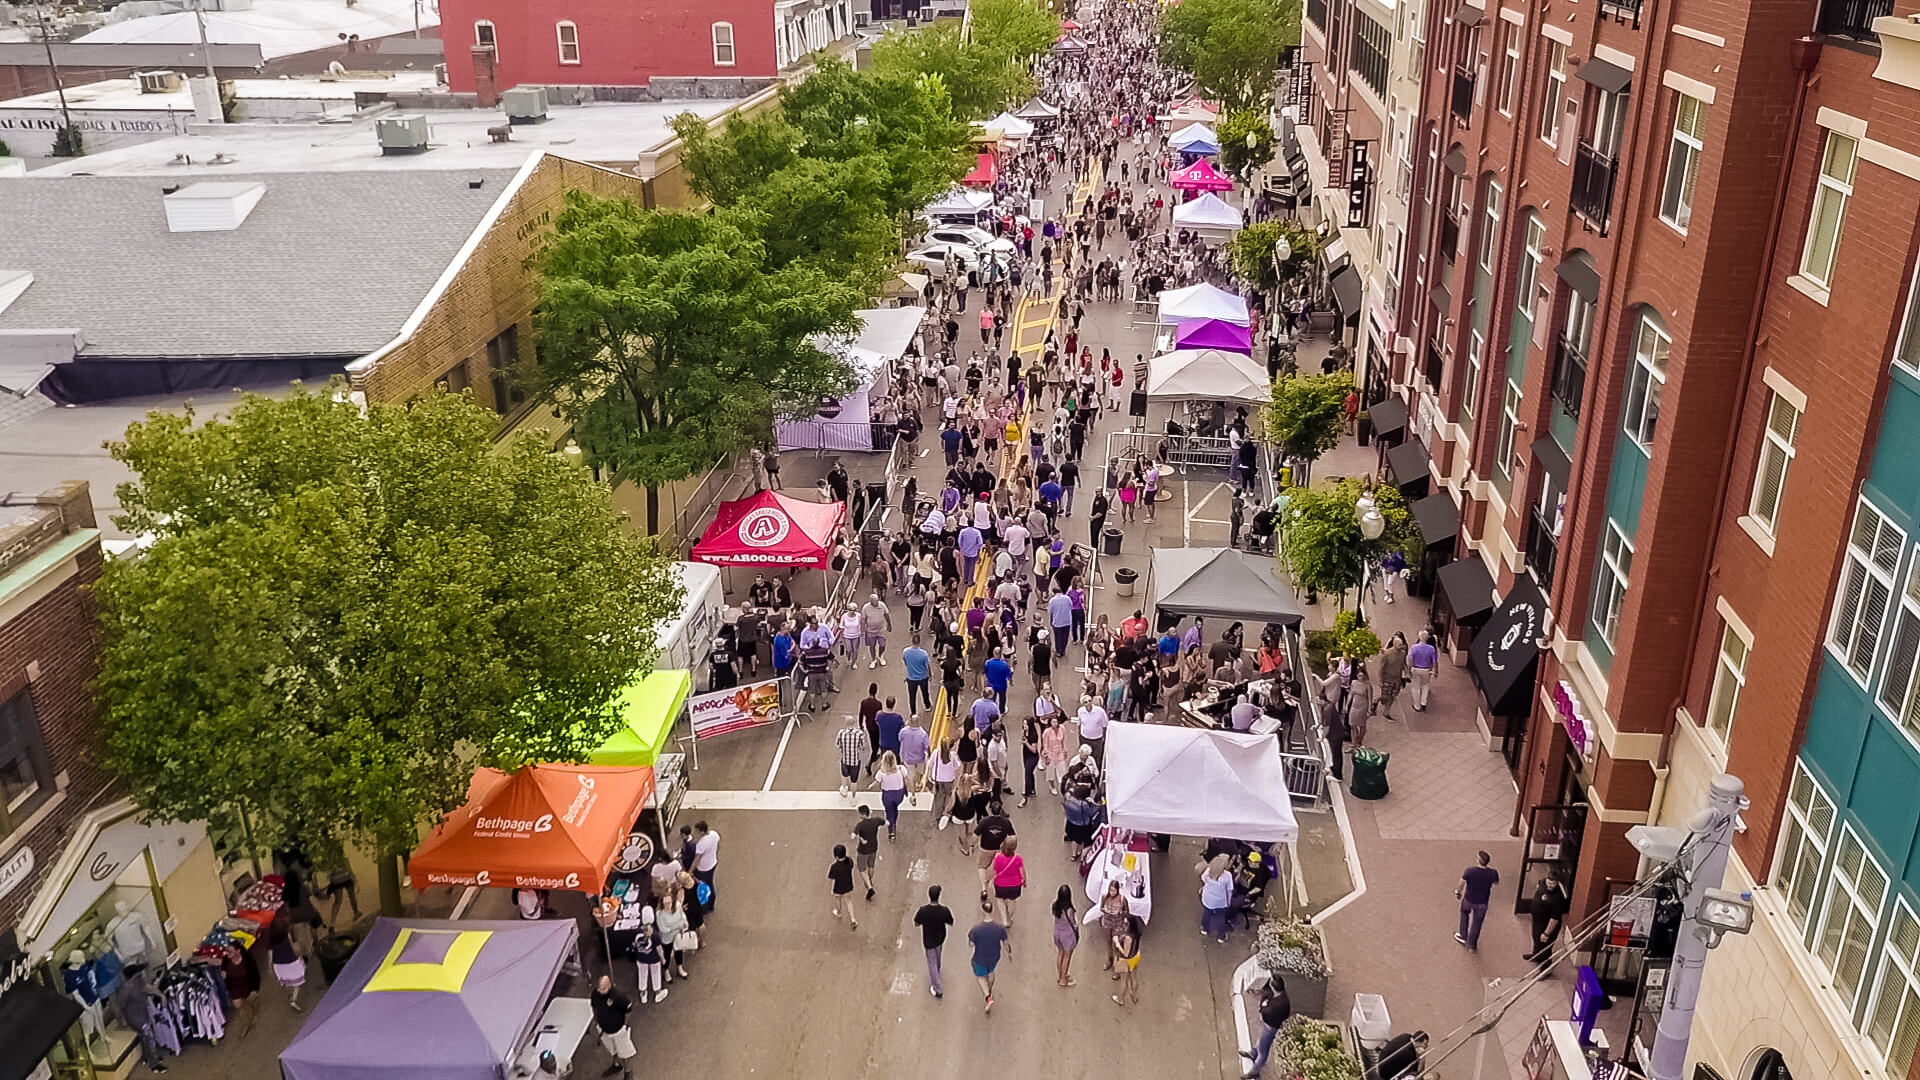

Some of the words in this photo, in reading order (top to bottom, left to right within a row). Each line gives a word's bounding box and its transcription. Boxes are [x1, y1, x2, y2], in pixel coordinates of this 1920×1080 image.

[1509, 603, 1527, 617] NEW
[476, 816, 534, 832] Bethpage
[427, 873, 476, 886] Bethpage
[515, 875, 564, 888] Bethpage
